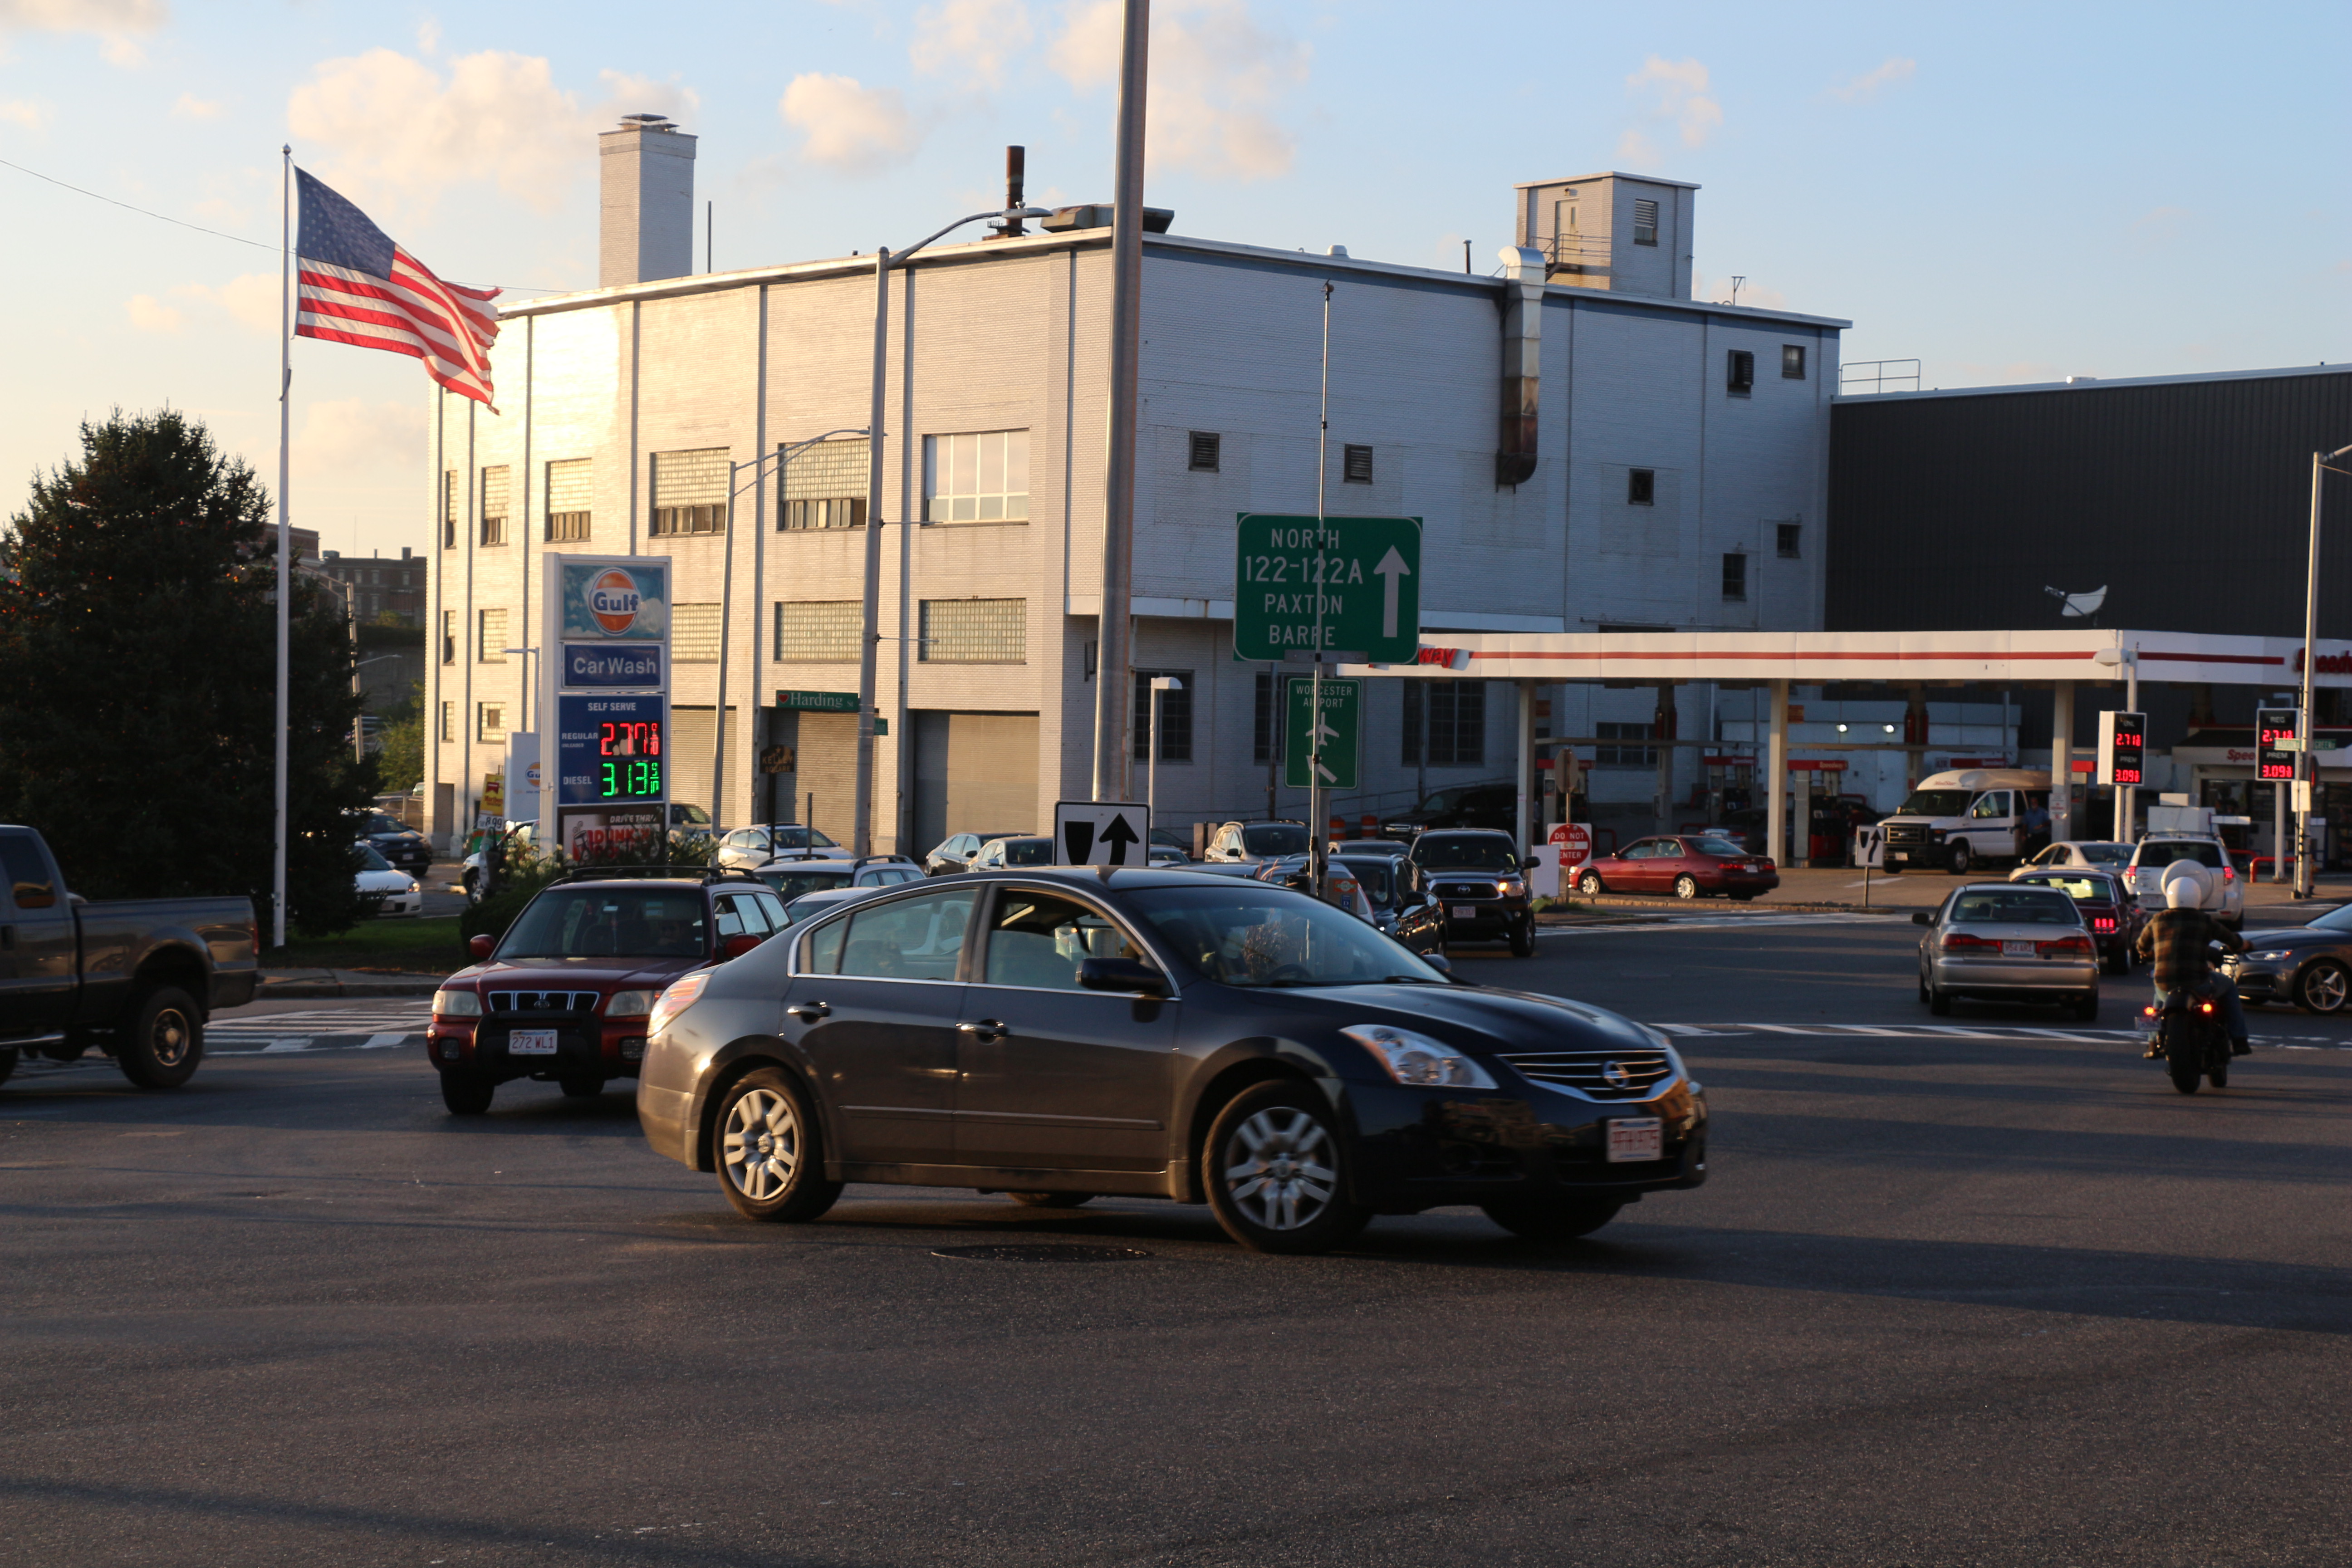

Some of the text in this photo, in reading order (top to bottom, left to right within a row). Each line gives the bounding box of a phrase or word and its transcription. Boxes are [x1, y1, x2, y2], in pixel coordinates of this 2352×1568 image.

[1245, 556, 1363, 584] 122-122A
[593, 591, 638, 611] Gulf
[1264, 593, 1343, 614] PAXTON
[1269, 624, 1335, 645] BARRE
[573, 657, 656, 674] Car Wash
[1296, 685, 1352, 696] WORCESTER
[790, 692, 843, 707] Harding
[1303, 698, 1343, 707] AIPORT
[588, 702, 636, 711] SELF SERVE
[2226, 749, 2255, 762] Spee
[526, 770, 540, 779] Gu
[563, 776, 592, 785] DIESEL
[512, 1036, 532, 1049] 272
